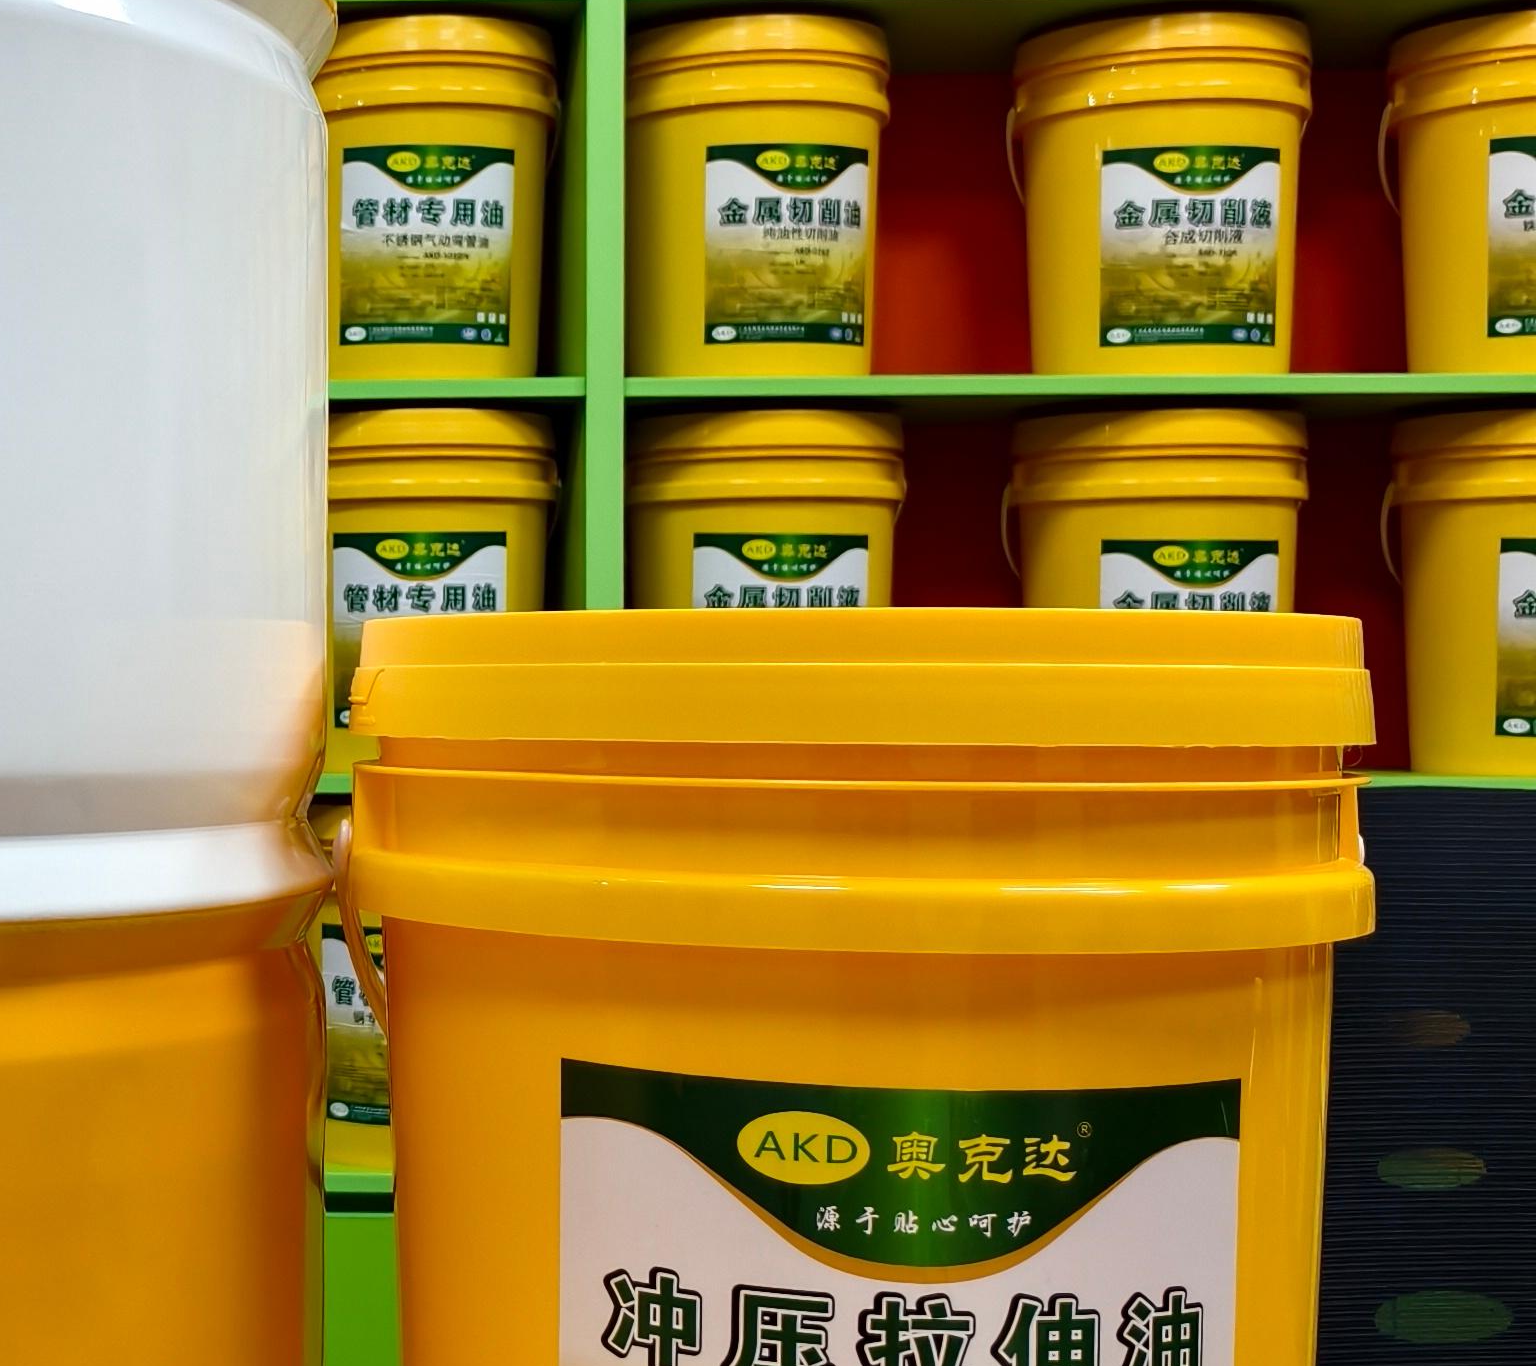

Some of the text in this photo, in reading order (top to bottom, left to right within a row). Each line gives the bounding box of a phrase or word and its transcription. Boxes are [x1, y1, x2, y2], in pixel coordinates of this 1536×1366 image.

[352, 197, 505, 229] 管材专用油
[718, 196, 862, 230] 金属切削油
[1114, 197, 1272, 230] 金属切削液
[343, 583, 497, 613] 管材专用油
[754, 1130, 1077, 1185] AKD 奥克达
[816, 1205, 1033, 1238] 源于贴心呵护
